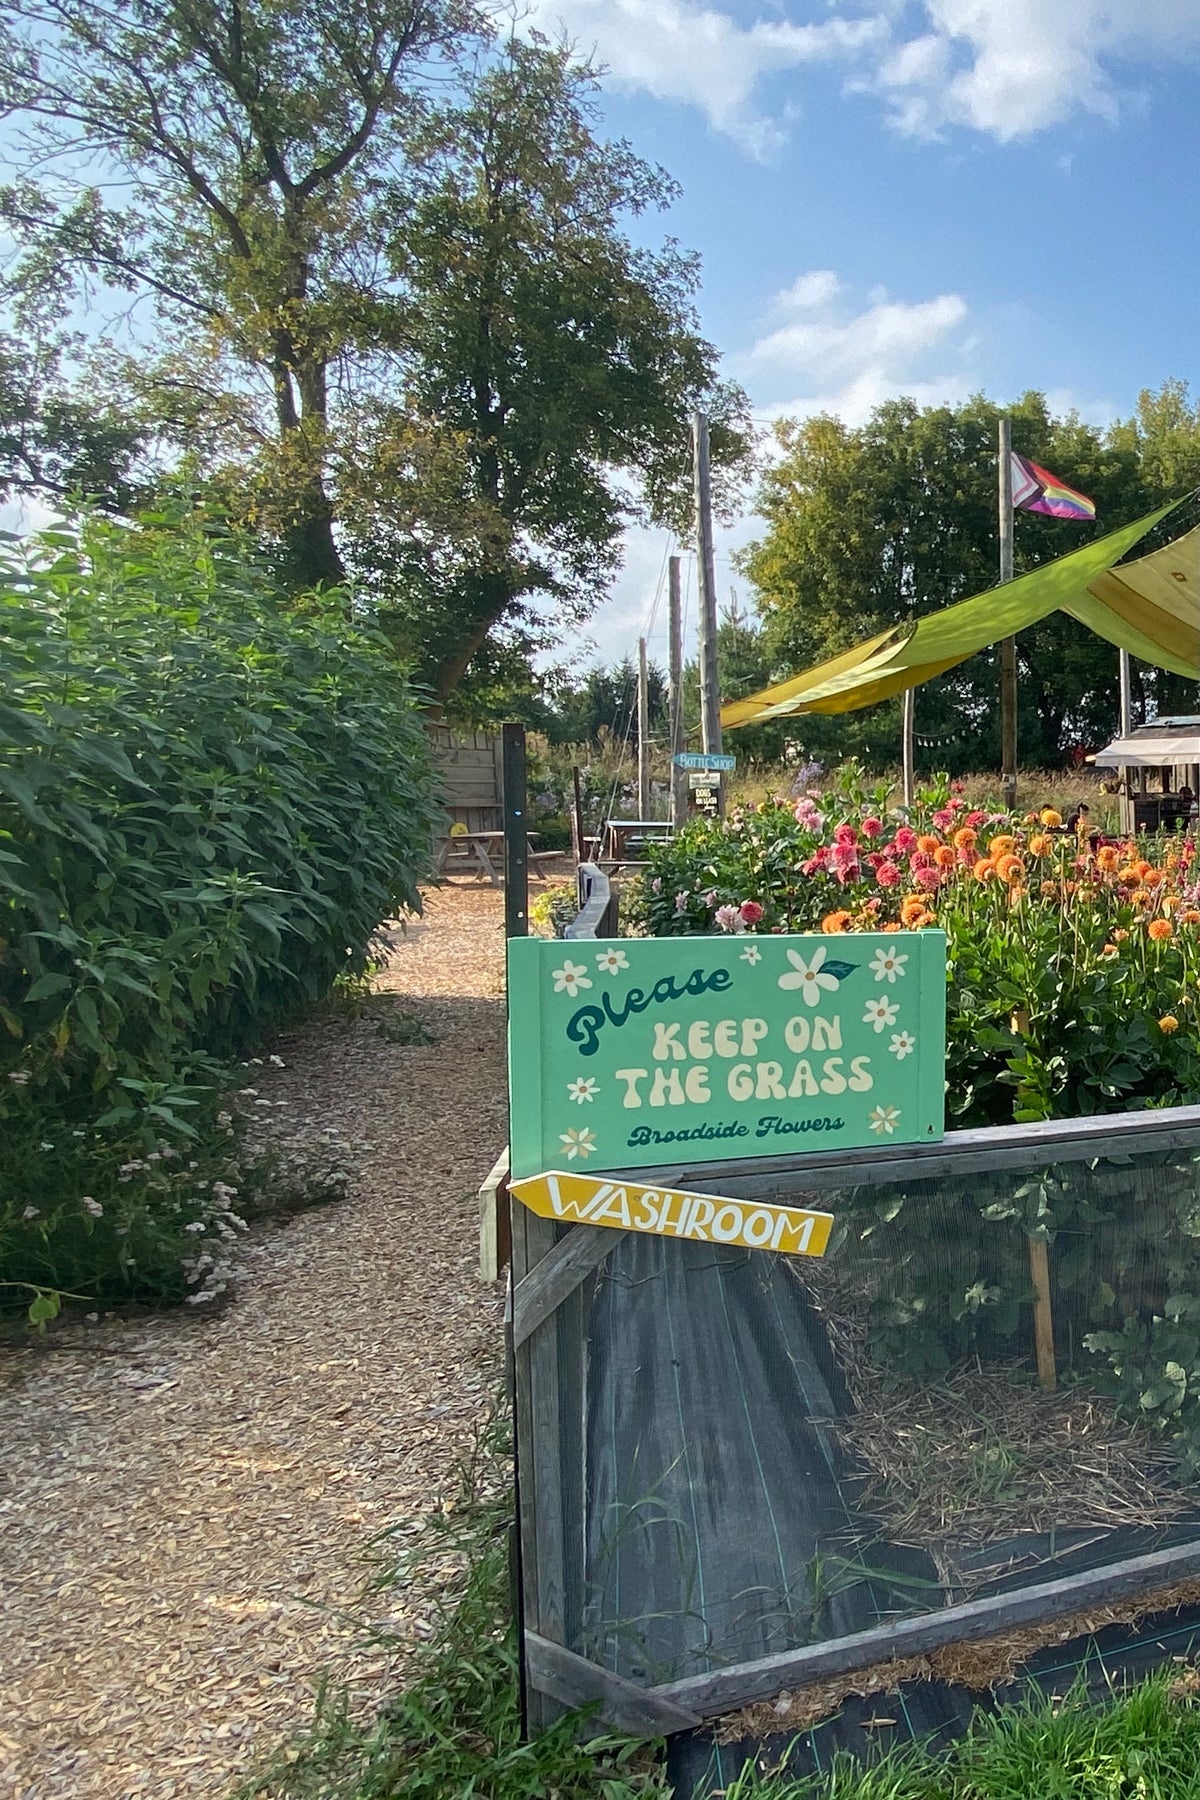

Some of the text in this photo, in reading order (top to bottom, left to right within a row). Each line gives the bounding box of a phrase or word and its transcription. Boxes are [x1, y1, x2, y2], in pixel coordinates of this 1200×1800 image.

[711, 756, 734, 770] SHOP
[566, 967, 733, 1056] Please
[652, 1015, 843, 1060] KEEP ON
[615, 1056, 874, 1108] THE GRASS
[627, 1116, 845, 1147] Broadside Flowers
[547, 1176, 815, 1252] WASHROOM
